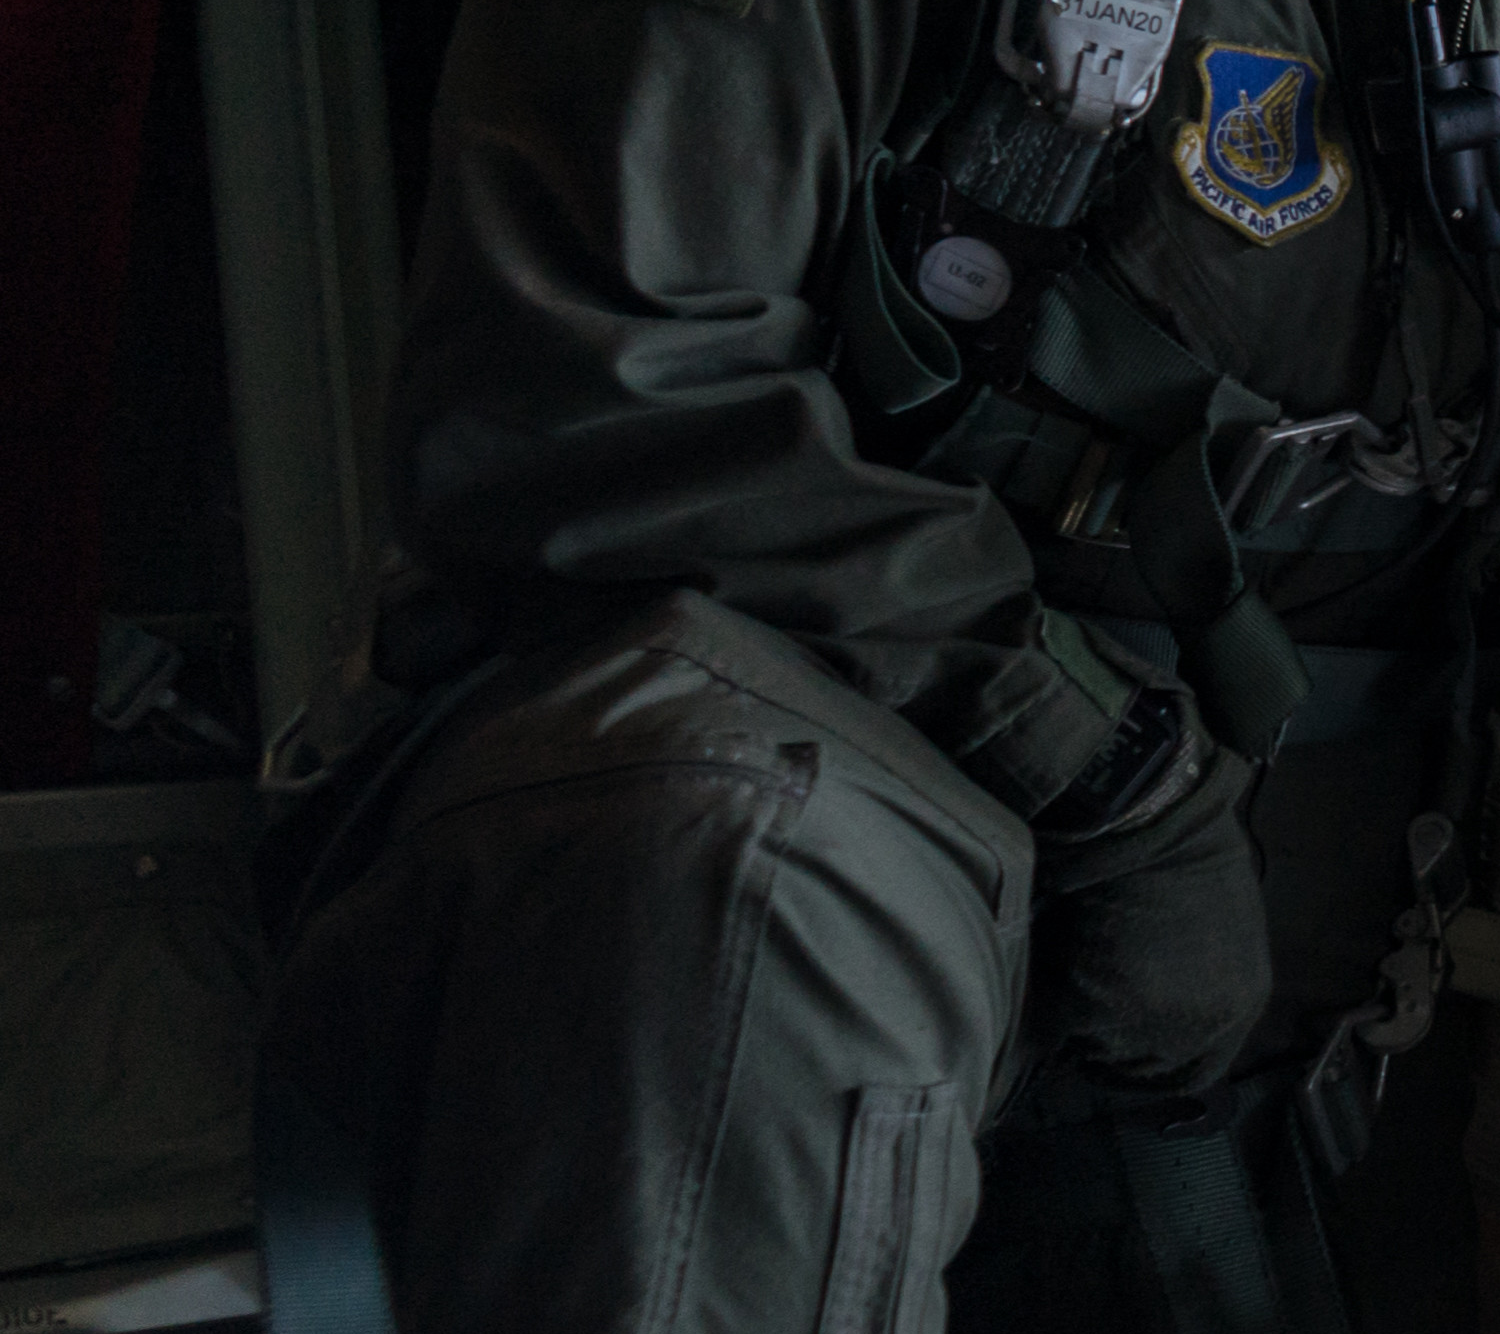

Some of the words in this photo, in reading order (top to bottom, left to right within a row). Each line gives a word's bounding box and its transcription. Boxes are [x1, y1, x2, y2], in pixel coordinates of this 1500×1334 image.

[1191, 166, 1248, 221] PACIFIC
[1248, 214, 1276, 235] AIR
[1278, 184, 1334, 226] FORCES
